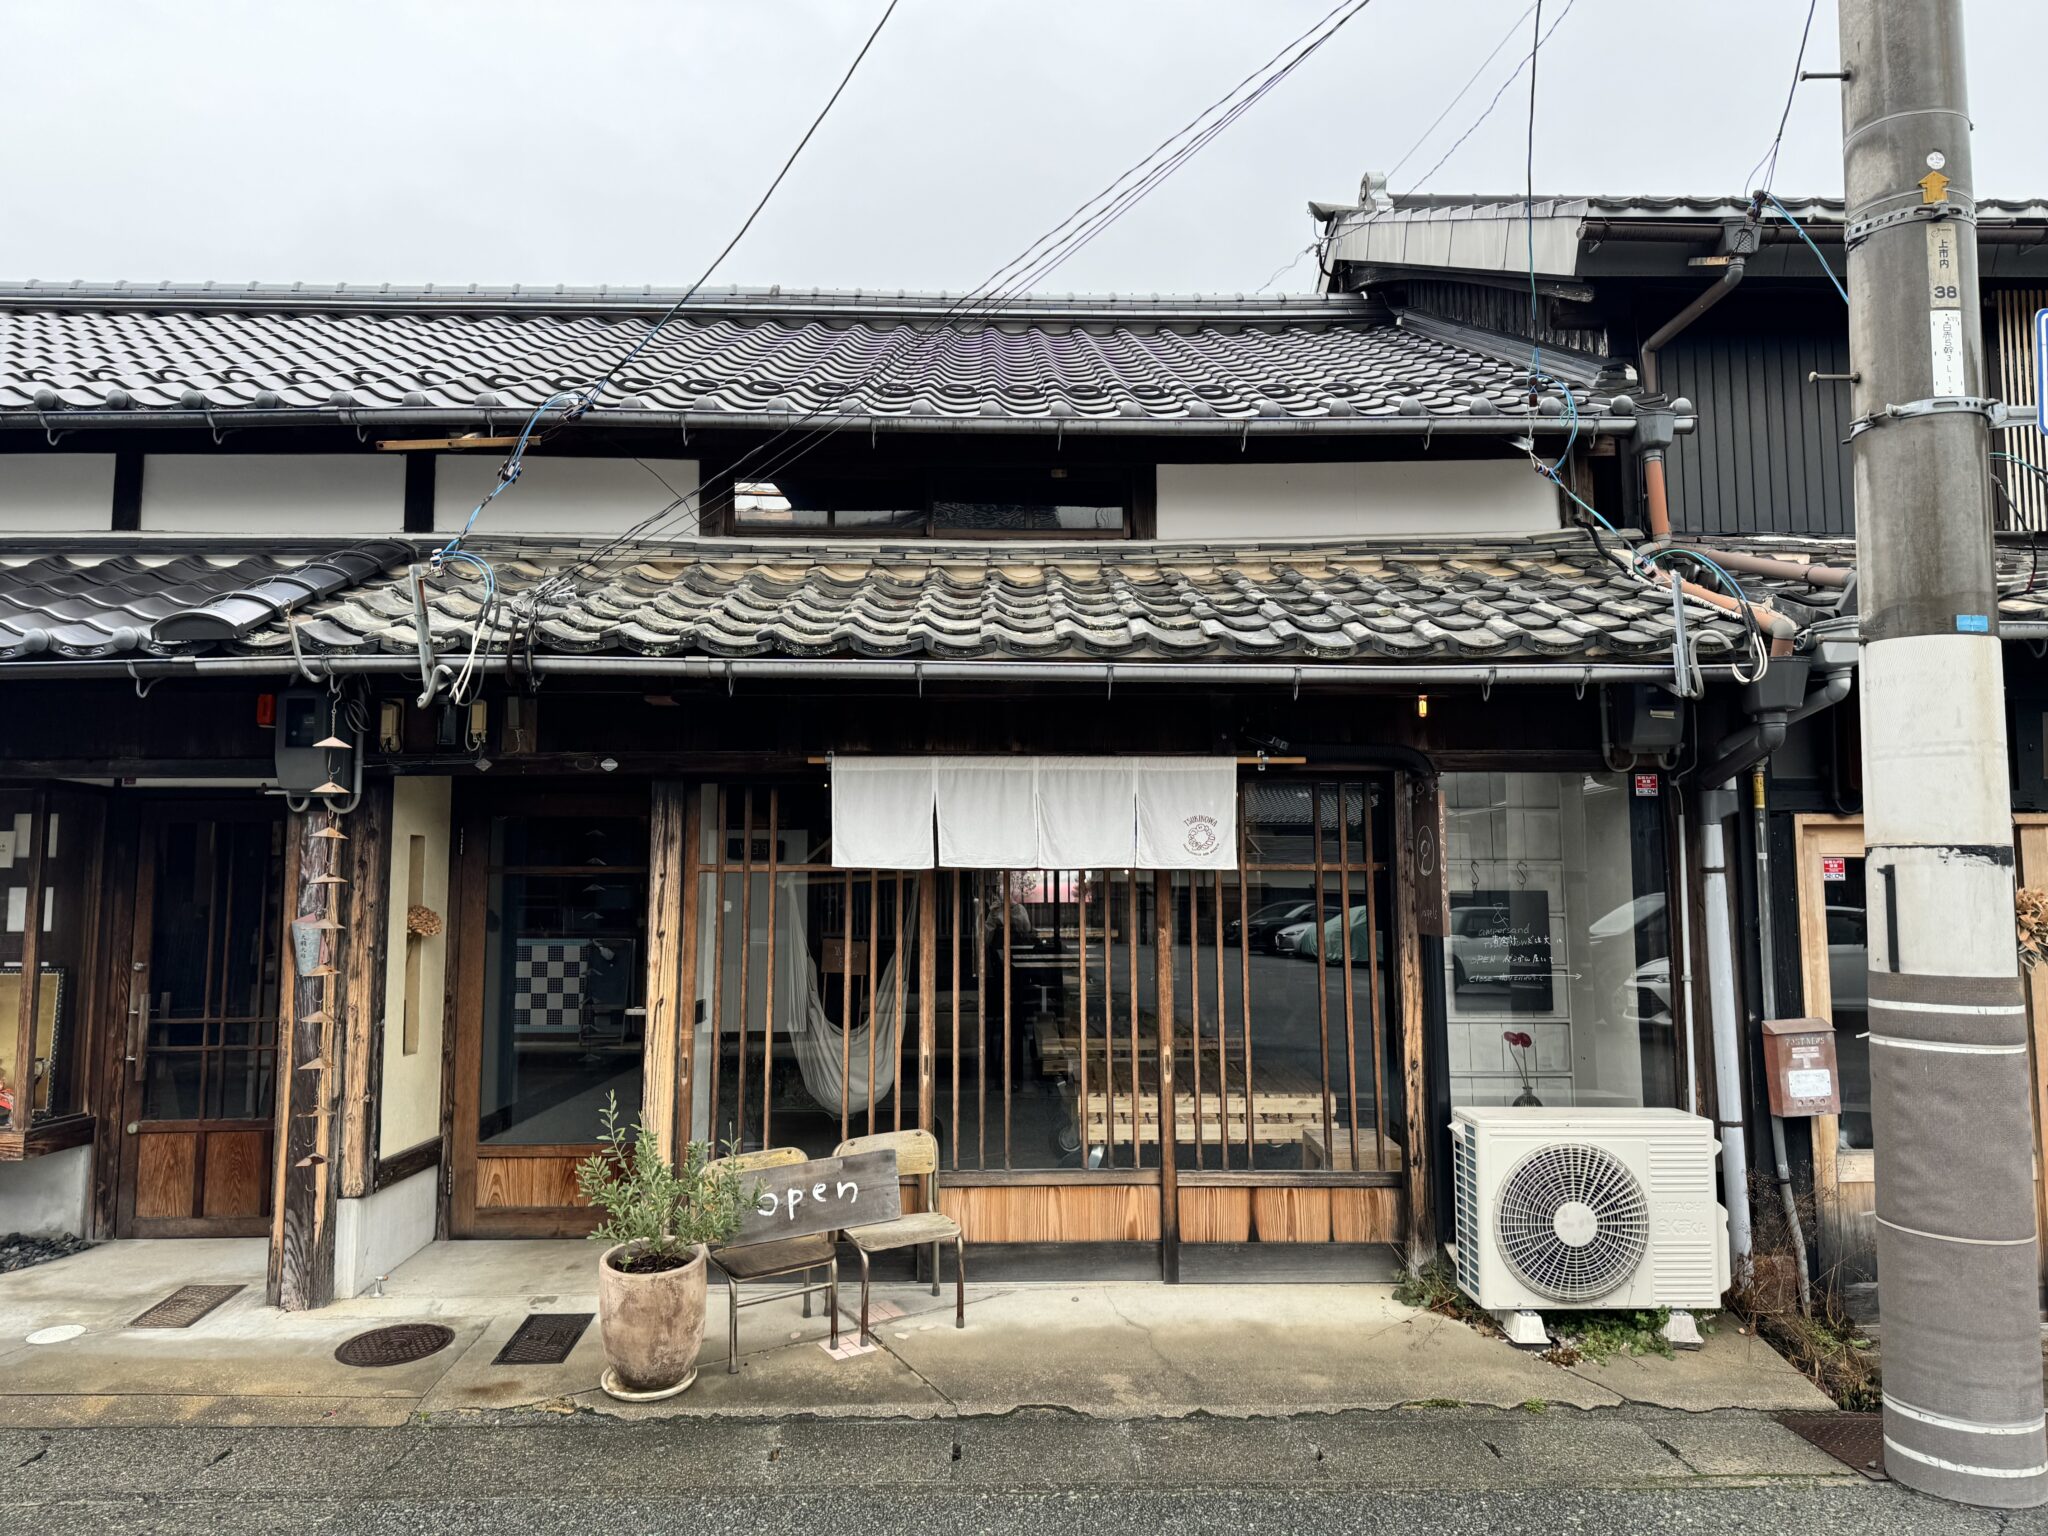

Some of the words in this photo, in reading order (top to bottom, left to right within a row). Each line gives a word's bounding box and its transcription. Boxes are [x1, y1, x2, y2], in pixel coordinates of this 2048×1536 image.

[1934, 285, 1958, 299] 38
[1184, 815, 1218, 827] TSUKINOWA
[756, 1181, 859, 1221] open
[1655, 1201, 1707, 1212] HITACHI
